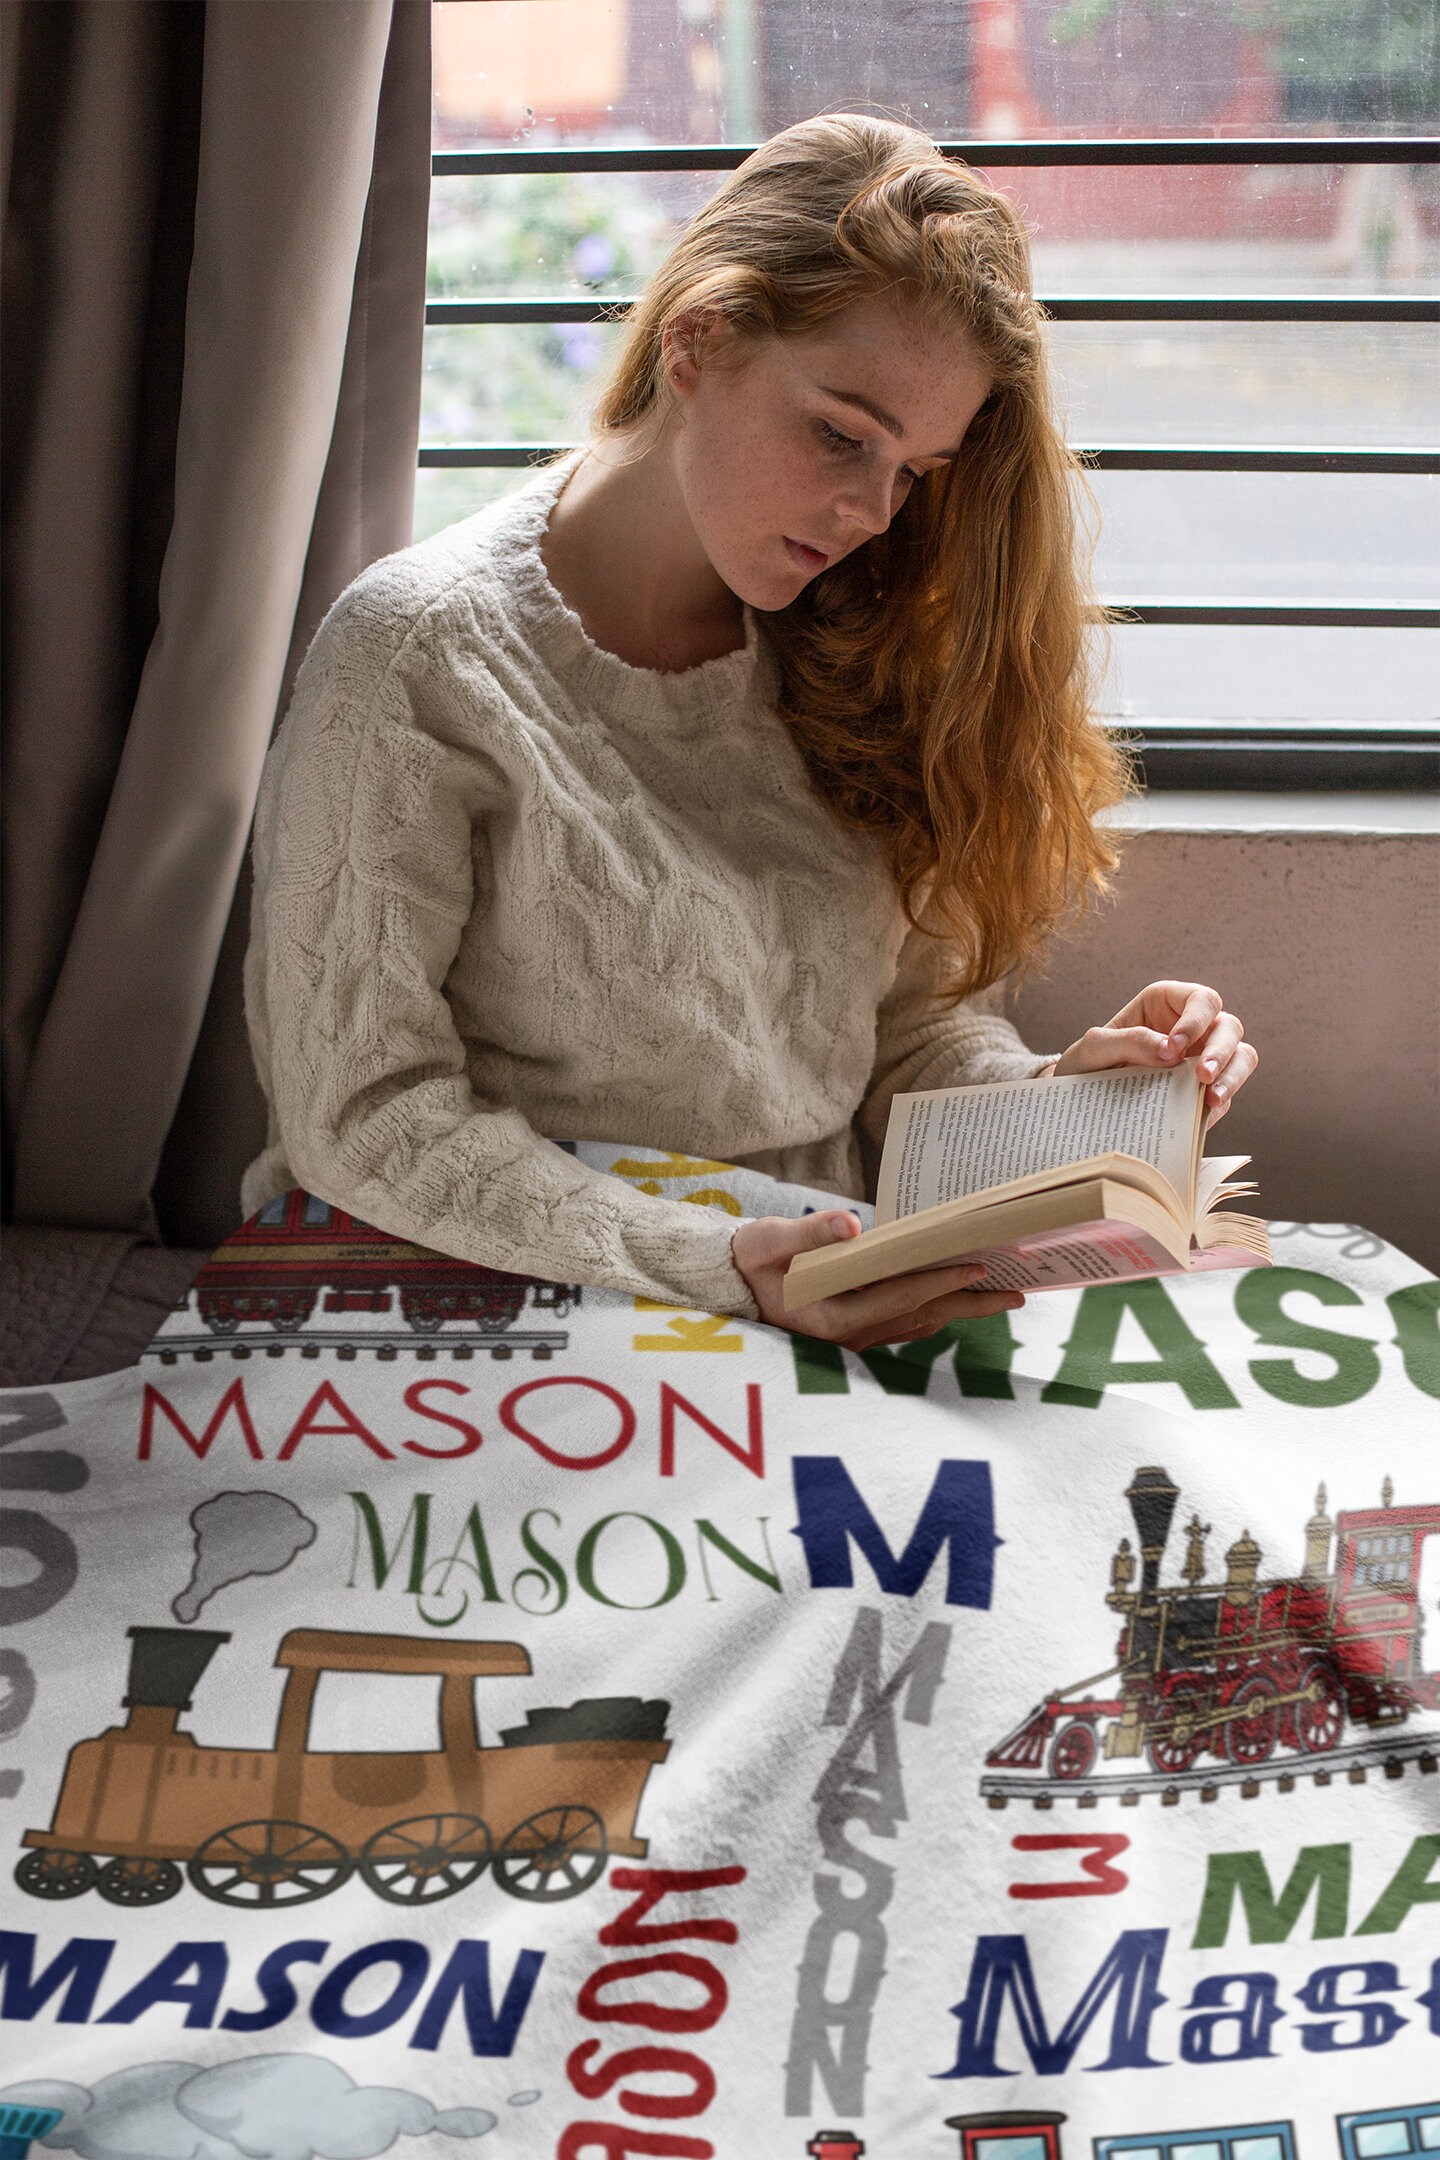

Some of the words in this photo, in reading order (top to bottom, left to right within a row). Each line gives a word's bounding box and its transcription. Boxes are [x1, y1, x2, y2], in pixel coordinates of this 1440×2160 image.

[138, 1376, 764, 1479] MASON
[345, 1491, 783, 1627] MASON
[790, 1456, 1005, 1611] M
[782, 1606, 952, 2119] MASON
[0, 1931, 547, 2058] MASON
[928, 1928, 1440, 2080] Mas
